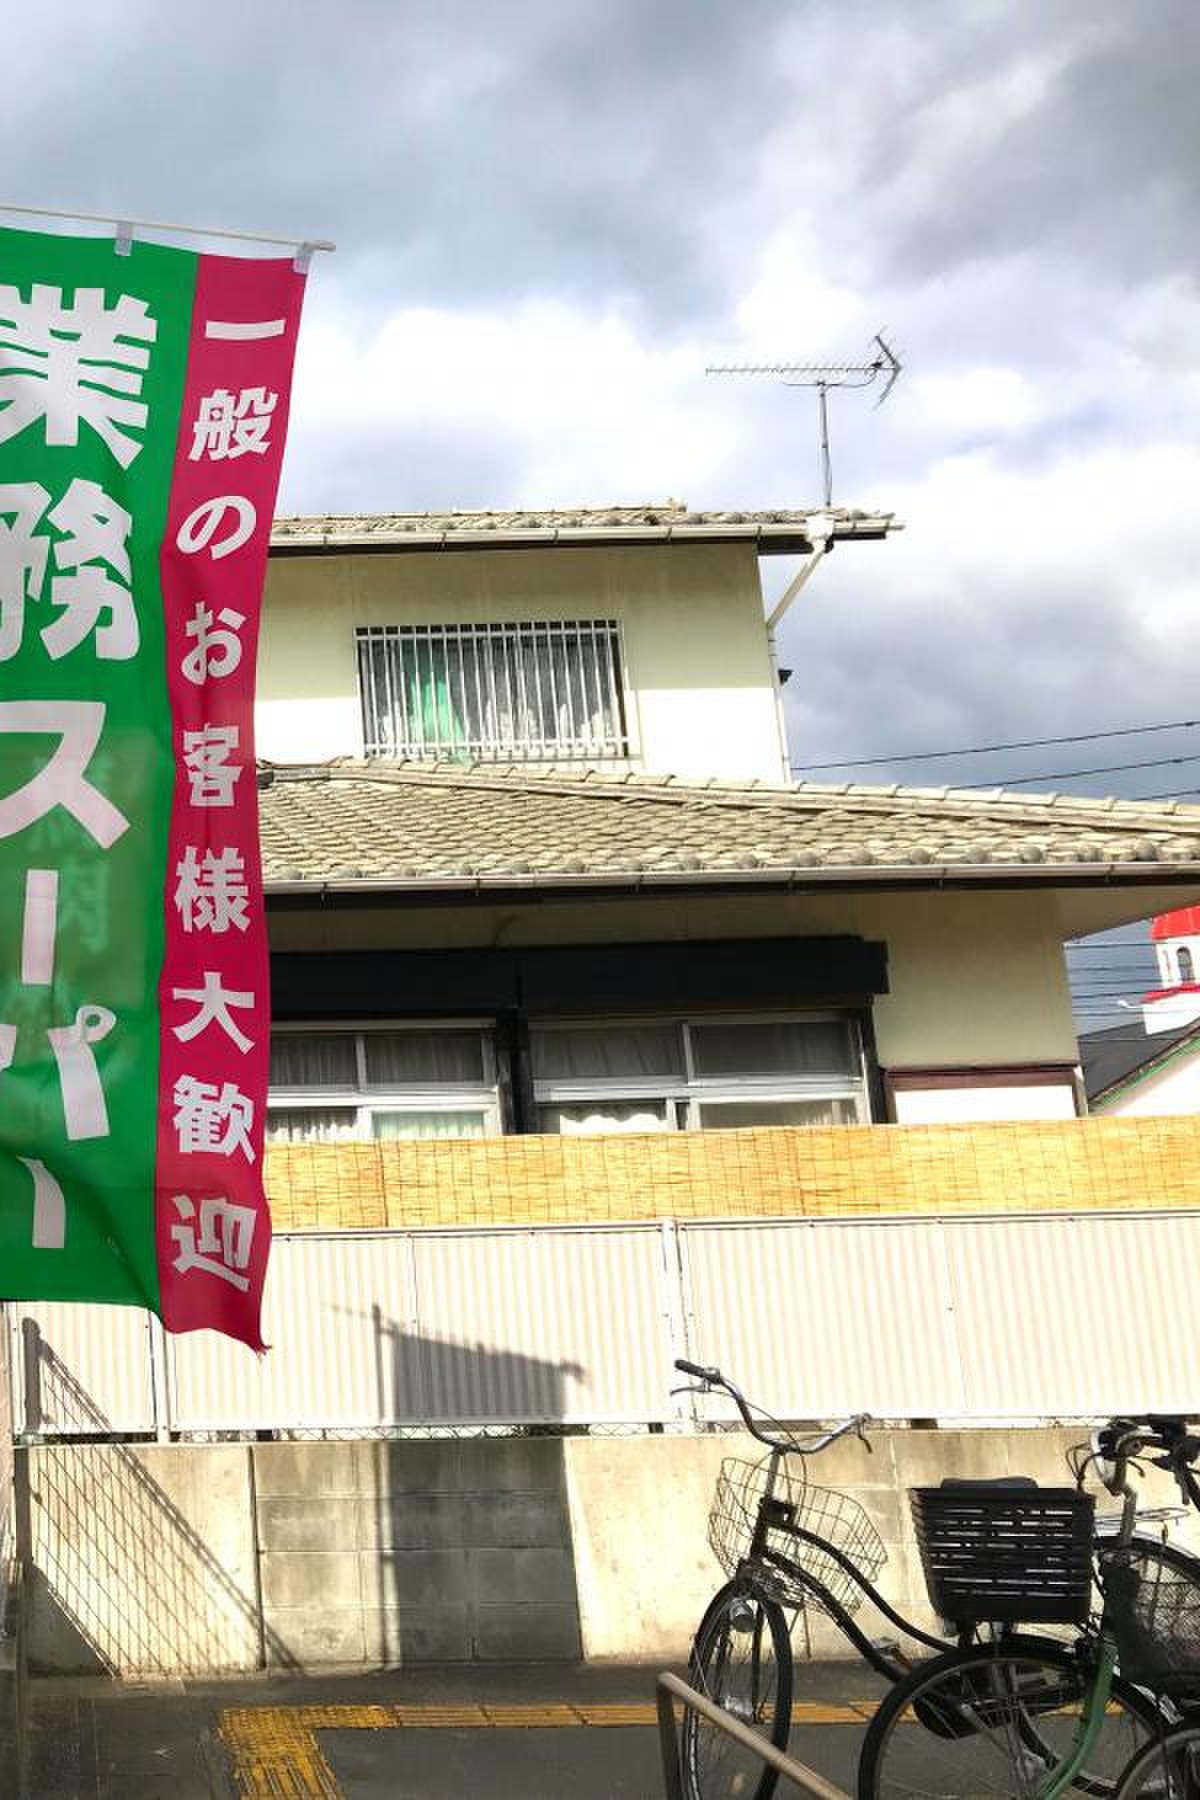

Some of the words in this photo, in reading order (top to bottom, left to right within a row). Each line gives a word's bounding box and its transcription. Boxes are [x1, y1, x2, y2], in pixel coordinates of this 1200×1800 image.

[172, 319, 286, 1292] 一般のお客様大歓迎
